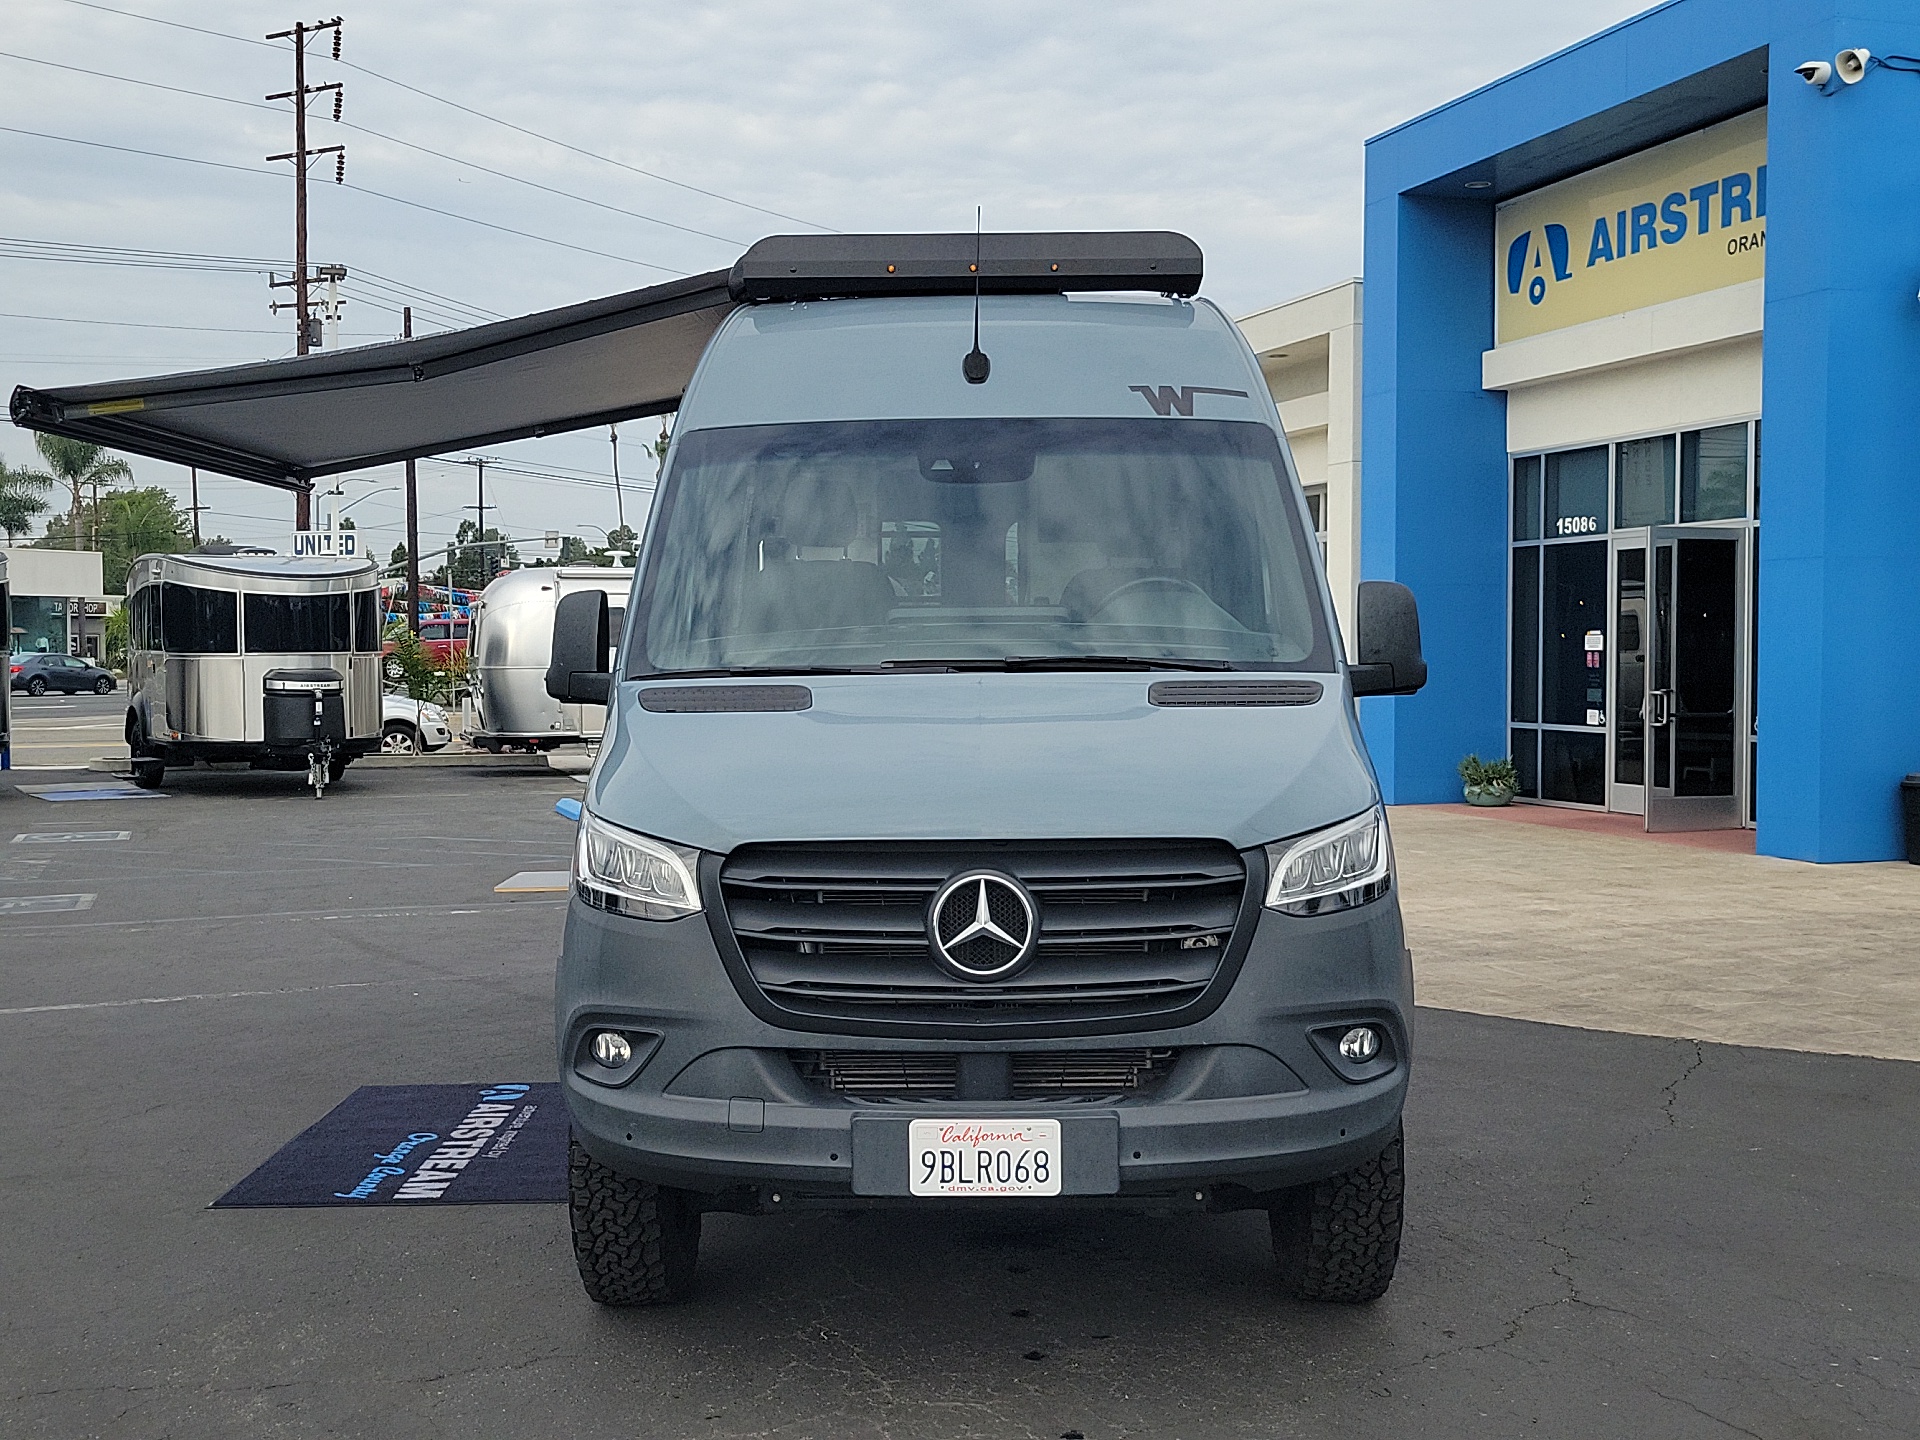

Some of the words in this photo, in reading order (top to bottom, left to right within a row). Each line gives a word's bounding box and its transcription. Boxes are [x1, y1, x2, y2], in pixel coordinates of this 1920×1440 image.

[1556, 516, 1597, 534] 15086
[374, 1133, 438, 1164] Orange
[392, 1104, 515, 1199] AIRSTREAM
[941, 1126, 1033, 1147] California
[334, 1166, 405, 1199] County
[920, 1150, 1050, 1184] 9BLR068
